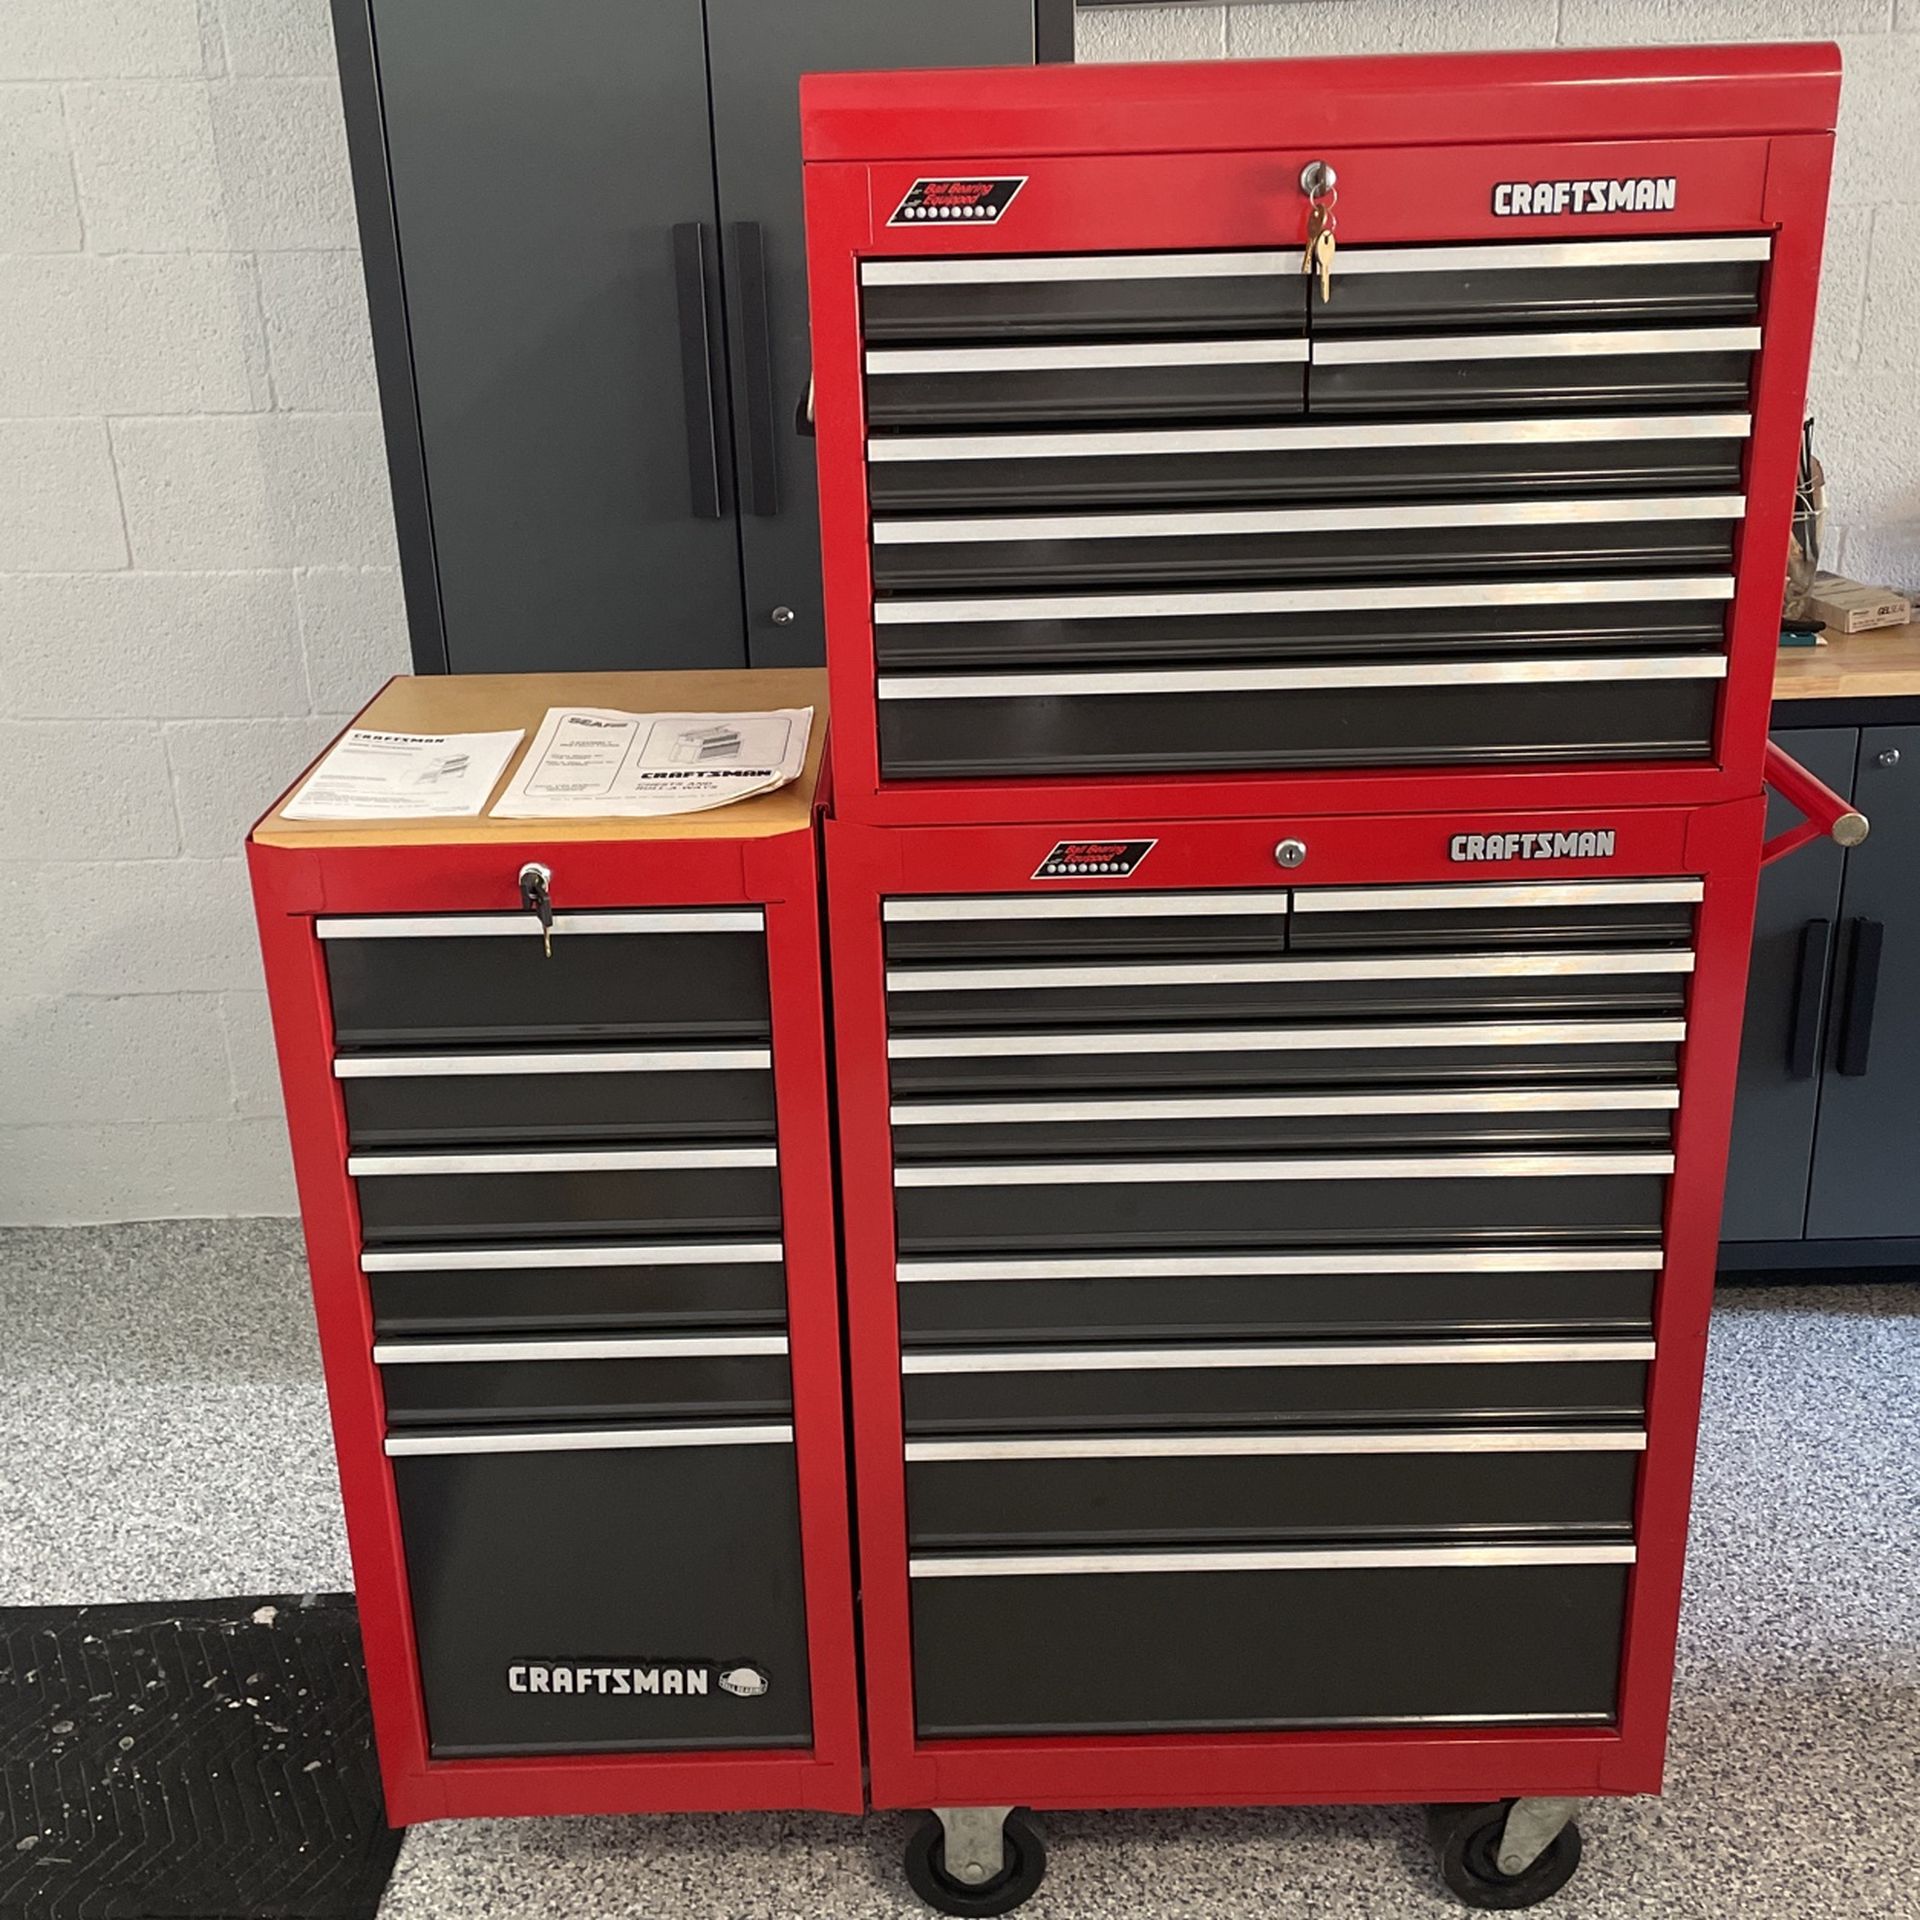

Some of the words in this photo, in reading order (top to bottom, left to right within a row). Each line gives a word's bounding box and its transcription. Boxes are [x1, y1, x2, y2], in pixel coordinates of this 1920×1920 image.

[924, 183, 948, 195] Ball
[949, 182, 995, 195] Bearing
[922, 194, 980, 206] Equipped
[1493, 178, 1677, 215] CRAFTSMAN
[640, 769, 772, 779] CRAFTSMAN
[1064, 845, 1085, 854] Ball
[1451, 831, 1616, 861] CRAFTSMAN
[508, 1666, 708, 1695] CRAFTSMAN
